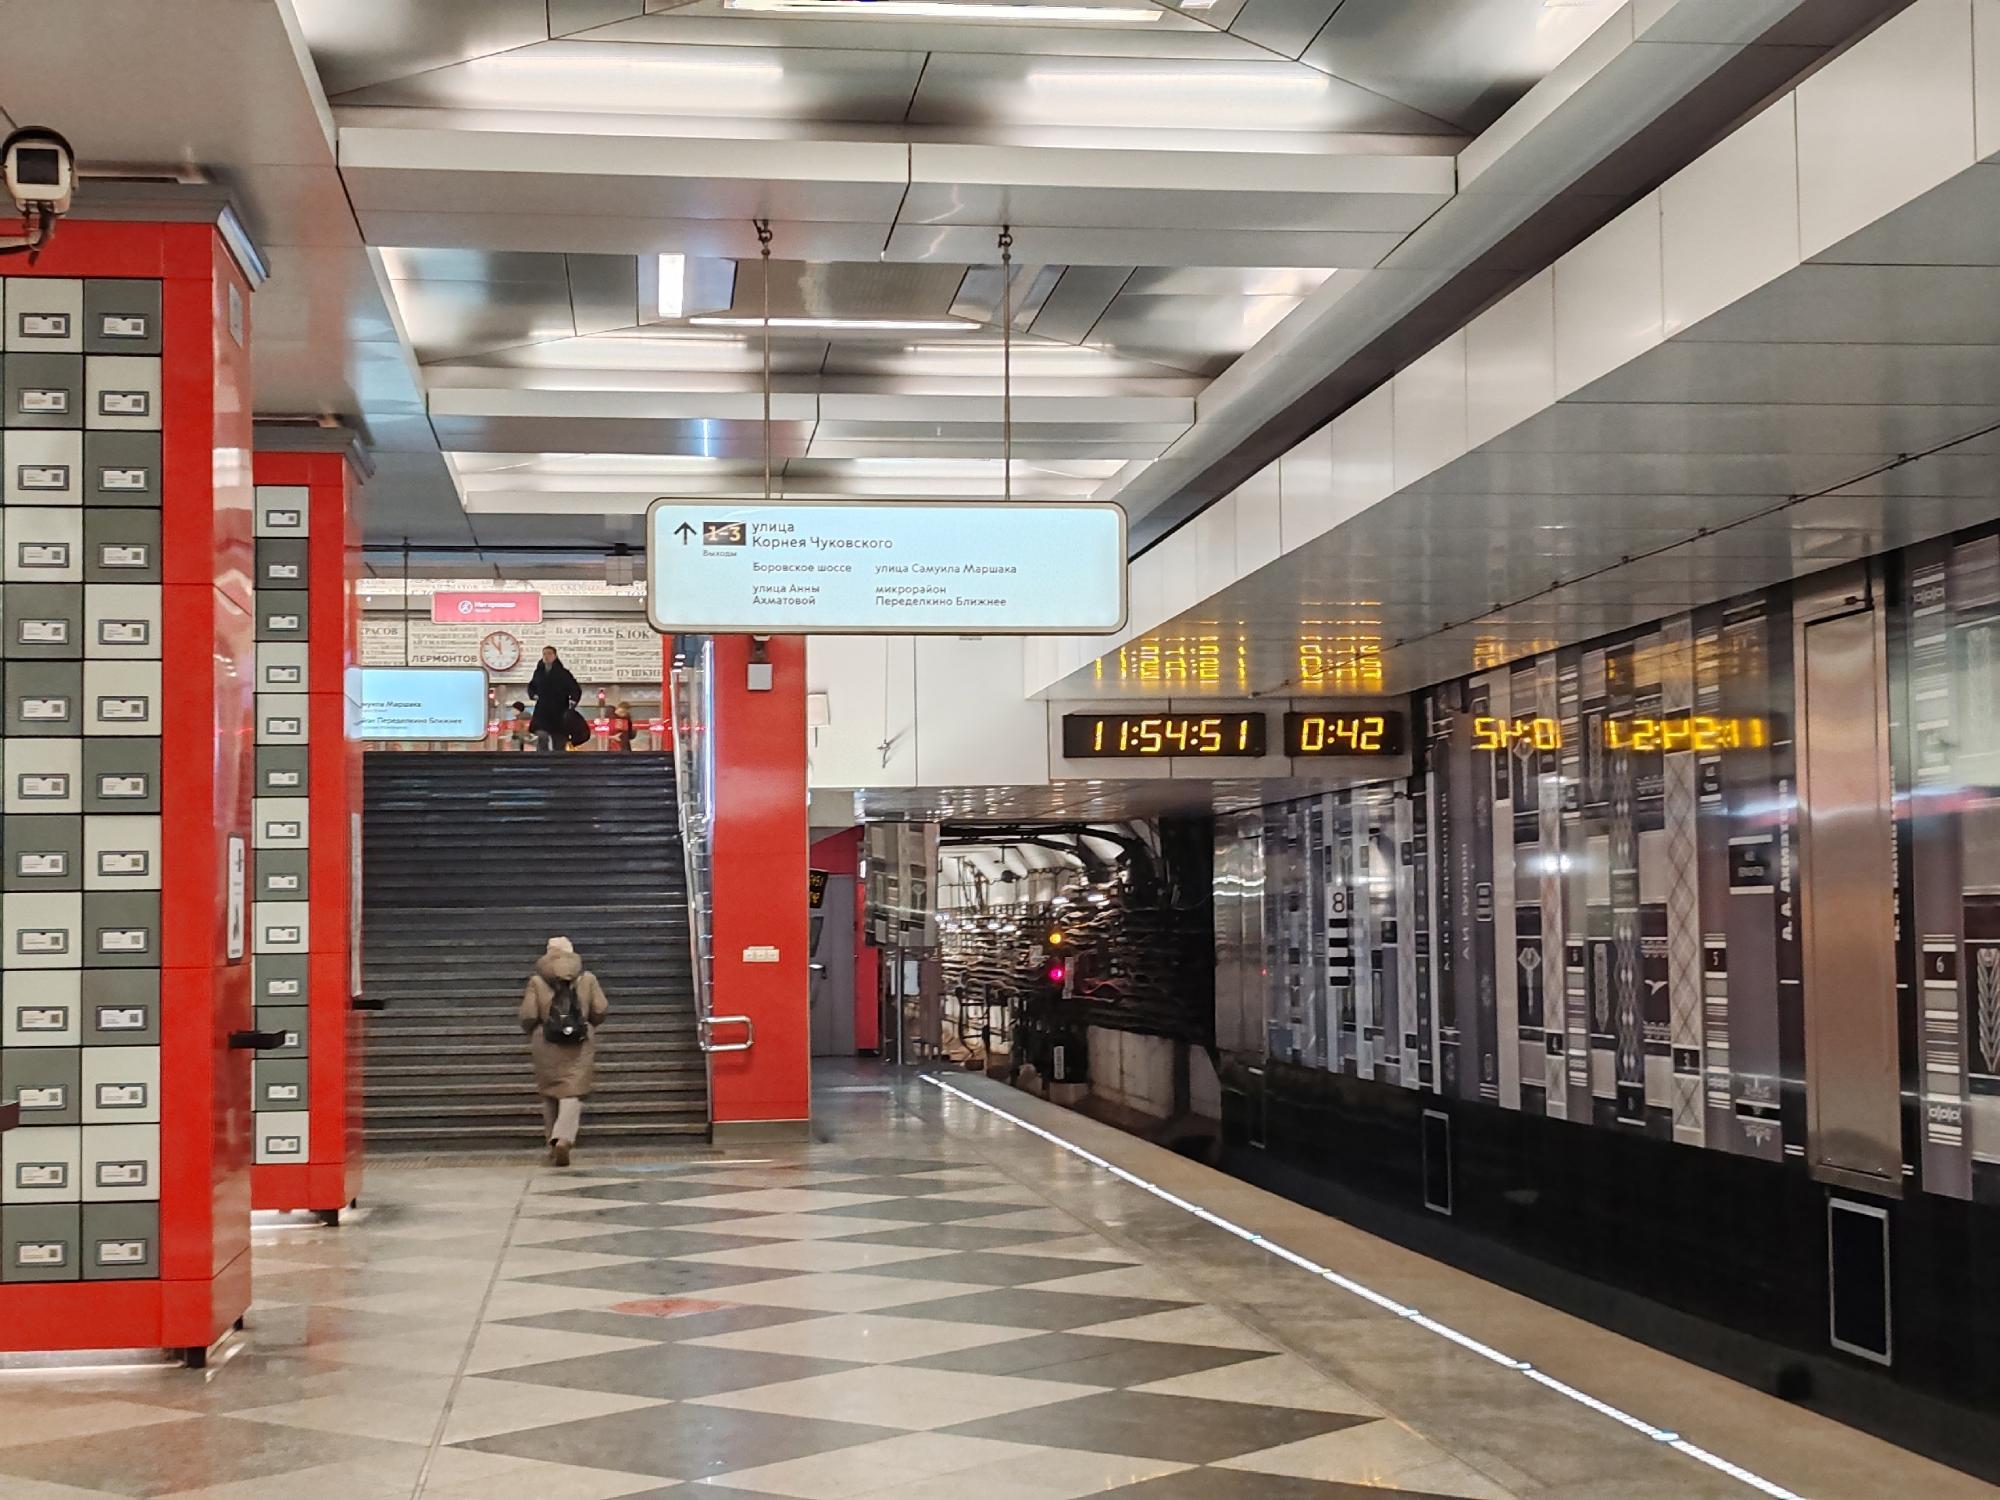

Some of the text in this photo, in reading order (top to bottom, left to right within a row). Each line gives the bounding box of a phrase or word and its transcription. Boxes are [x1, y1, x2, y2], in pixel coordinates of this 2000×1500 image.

[752, 522, 795, 535] улица
[752, 536, 893, 551] Корнея Чуковского
[703, 549, 737, 557] Выходы
[752, 562, 852, 573] Боровское шоссе
[875, 563, 1017, 575] улица Самуила Маршака
[752, 584, 820, 594] улица Анны
[875, 584, 947, 595] микрорайон
[752, 596, 816, 606] Ахматовой
[875, 596, 1007, 607] Переделкино Ближнее
[412, 655, 478, 663] ЛЕРМОНТОВ
[1094, 719, 1248, 752] 11:54:51
[1301, 717, 1384, 751] 0:42
